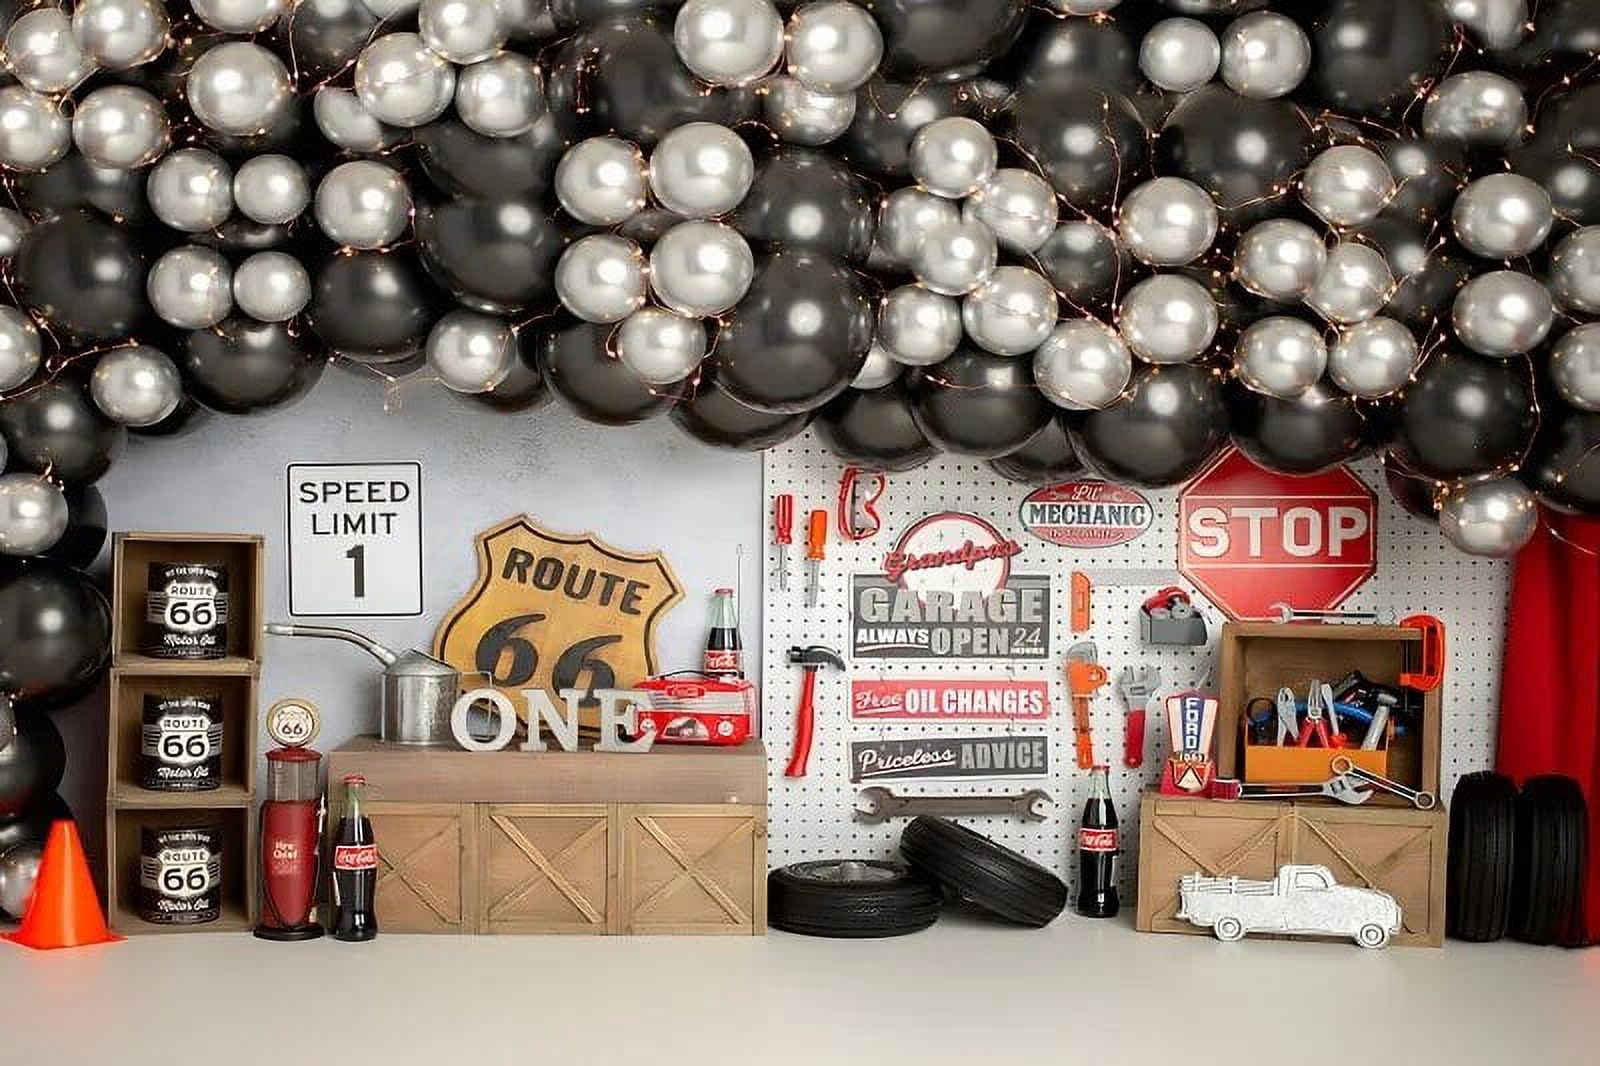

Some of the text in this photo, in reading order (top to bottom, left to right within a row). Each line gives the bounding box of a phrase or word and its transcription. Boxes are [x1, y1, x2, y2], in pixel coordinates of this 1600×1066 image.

[299, 481, 411, 504] SPEED
[311, 512, 398, 535] LIMIT
[1029, 503, 1146, 526] MECHANIC
[1188, 506, 1368, 558] STOP
[346, 544, 366, 598] 1
[501, 547, 651, 616] ROUTE
[170, 585, 213, 596] ROUTE
[170, 602, 212, 625] 66
[859, 588, 1044, 623] GARAGE
[856, 628, 1042, 656] ALWAYS OPEN 24
[475, 613, 624, 708] 66
[855, 688, 1043, 714] Free OIL CHANGES
[164, 719, 206, 729] ROUTE
[282, 723, 303, 734] 66
[450, 688, 658, 753] ONE
[1186, 697, 1200, 749] FORD
[164, 735, 205, 757] 66
[858, 742, 1044, 771] Priceless ADVICE
[164, 852, 206, 861] ROUTE
[164, 866, 205, 891] 66
